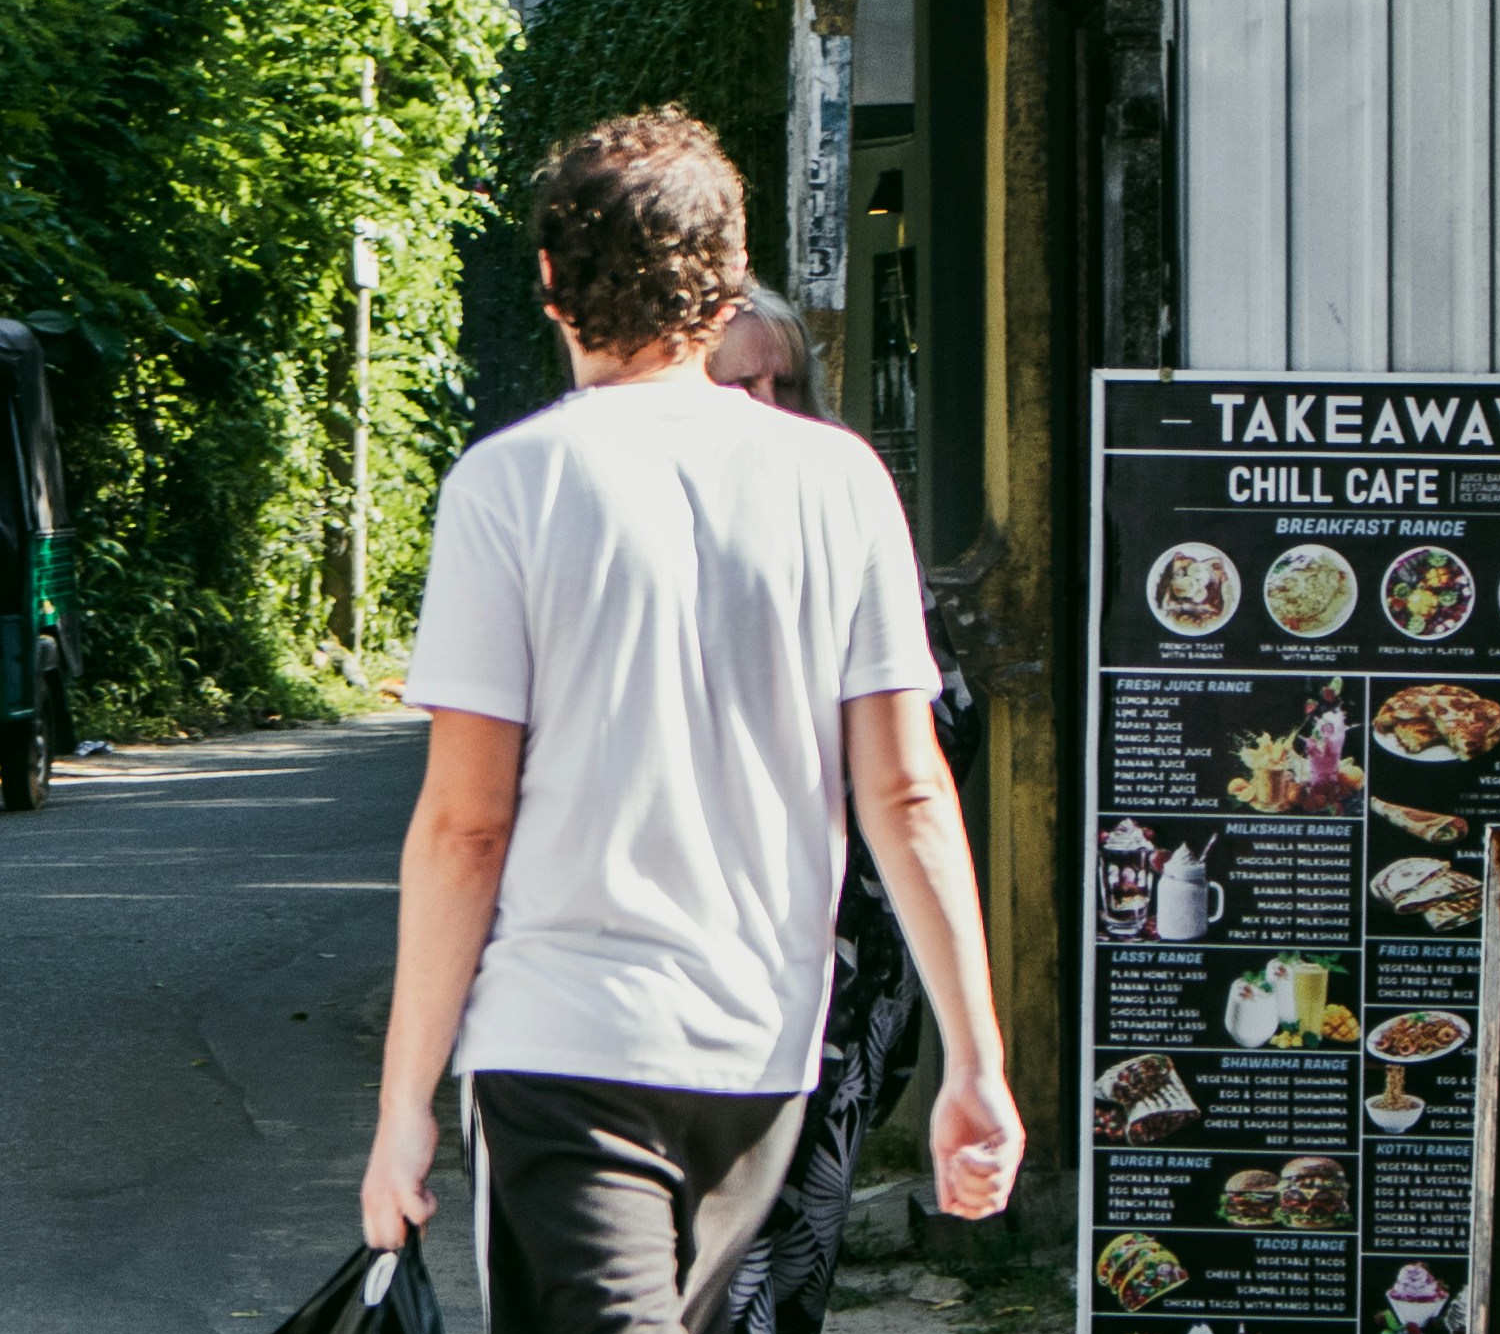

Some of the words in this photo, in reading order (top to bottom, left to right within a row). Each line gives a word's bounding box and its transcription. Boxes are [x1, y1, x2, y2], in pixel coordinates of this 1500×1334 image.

[1228, 466, 1333, 503] CHILL
[1346, 468, 1440, 505] CAFE
[1275, 517, 1395, 535] BREAKFAST
[1399, 519, 1466, 536] RANGE
[1116, 679, 1161, 691] FRESH
[1164, 680, 1204, 692] JUICE
[1207, 681, 1253, 693] RANGE
[1115, 697, 1149, 706] LEMON
[1152, 697, 1180, 706] JUICE
[1115, 709, 1138, 718] LIME
[1142, 709, 1170, 718] JUICE
[1114, 772, 1164, 781] PINEAPPLE
[1169, 772, 1197, 781] JUICE
[1226, 823, 1305, 835] MILKSHAKE
[1307, 824, 1353, 836] RANGE
[1112, 951, 1154, 963] LASSY
[1158, 952, 1204, 964] RANGE
[1379, 945, 1419, 957] FRIED
[1421, 945, 1453, 958] RICE
[1221, 1057, 1300, 1068] SHAWARMA
[1303, 1059, 1349, 1070] RANGE
[1376, 1143, 1424, 1155] KOTTU
[1426, 1145, 1471, 1157] RANGE
[1110, 1155, 1164, 1167] BURGER
[1167, 1156, 1213, 1168] RANGE
[1108, 1174, 1151, 1183] CHICKEN
[1153, 1175, 1191, 1184] BURGER
[1255, 1238, 1299, 1250] TACOS
[1302, 1239, 1347, 1251] RANGE
